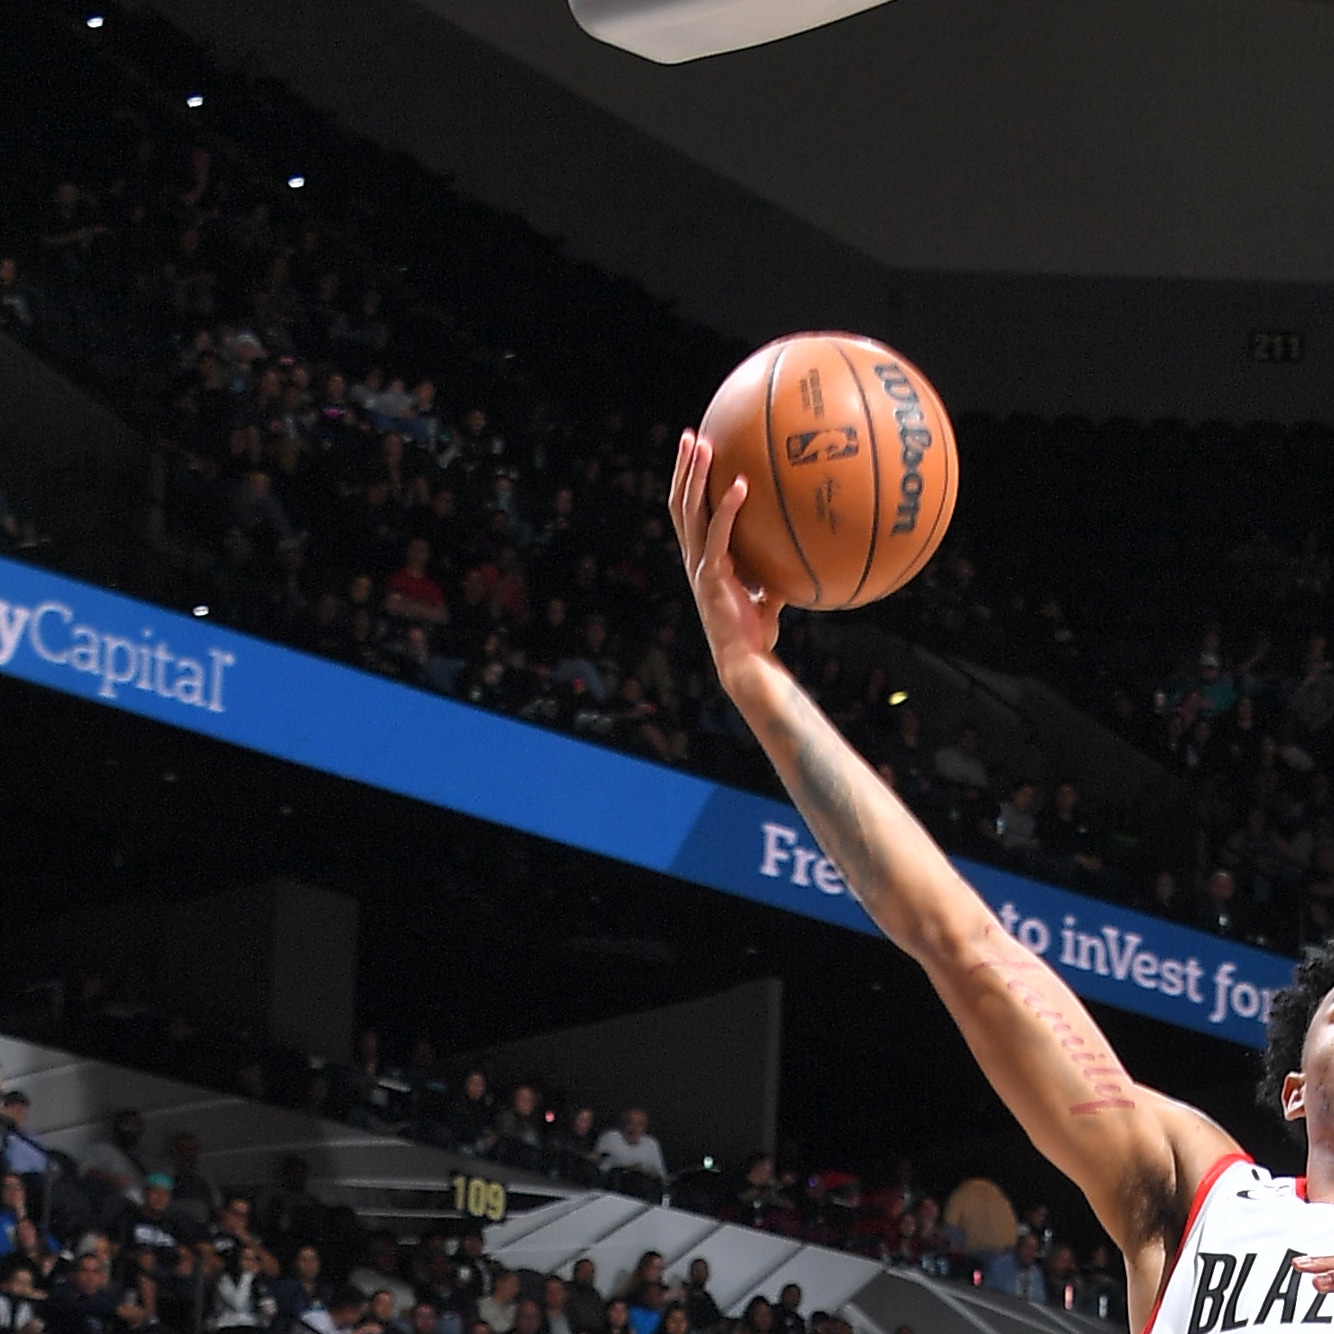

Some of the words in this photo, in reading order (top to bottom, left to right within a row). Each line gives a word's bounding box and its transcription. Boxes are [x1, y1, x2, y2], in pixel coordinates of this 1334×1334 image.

[874, 362, 933, 537] Wilson
[1058, 916, 1203, 1003] inVest
[453, 1176, 506, 1220] 109
